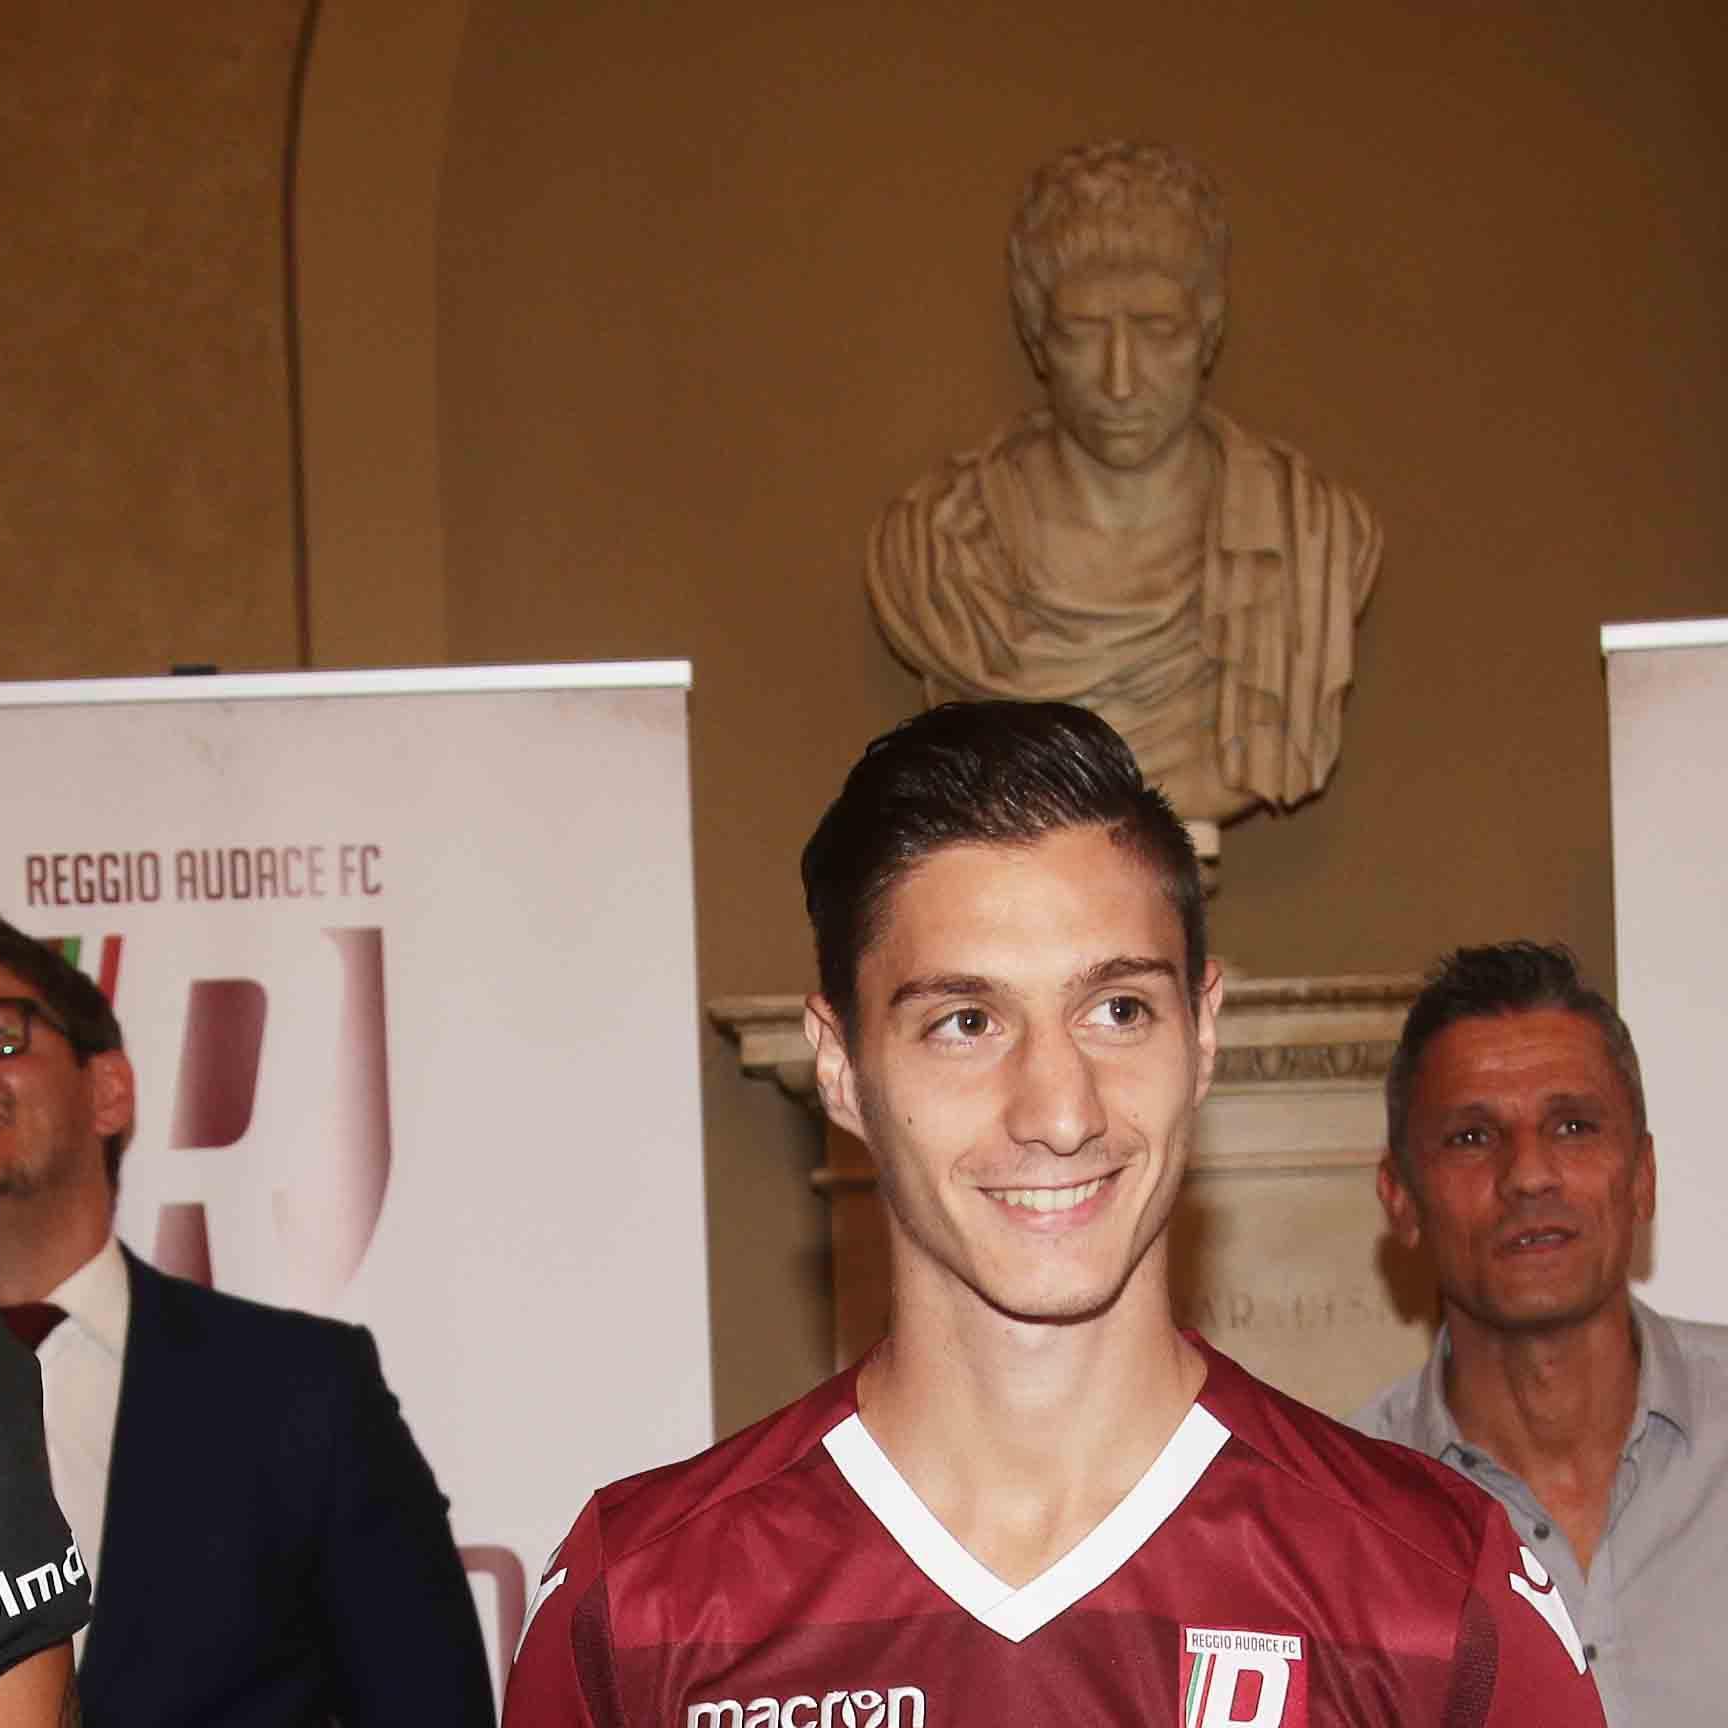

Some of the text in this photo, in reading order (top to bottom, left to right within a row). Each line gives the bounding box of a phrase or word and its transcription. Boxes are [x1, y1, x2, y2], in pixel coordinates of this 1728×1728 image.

[25, 844, 383, 907] REGGIO AUDACE FC
[1191, 1632, 1296, 1654] REGGIO AUDACE FC
